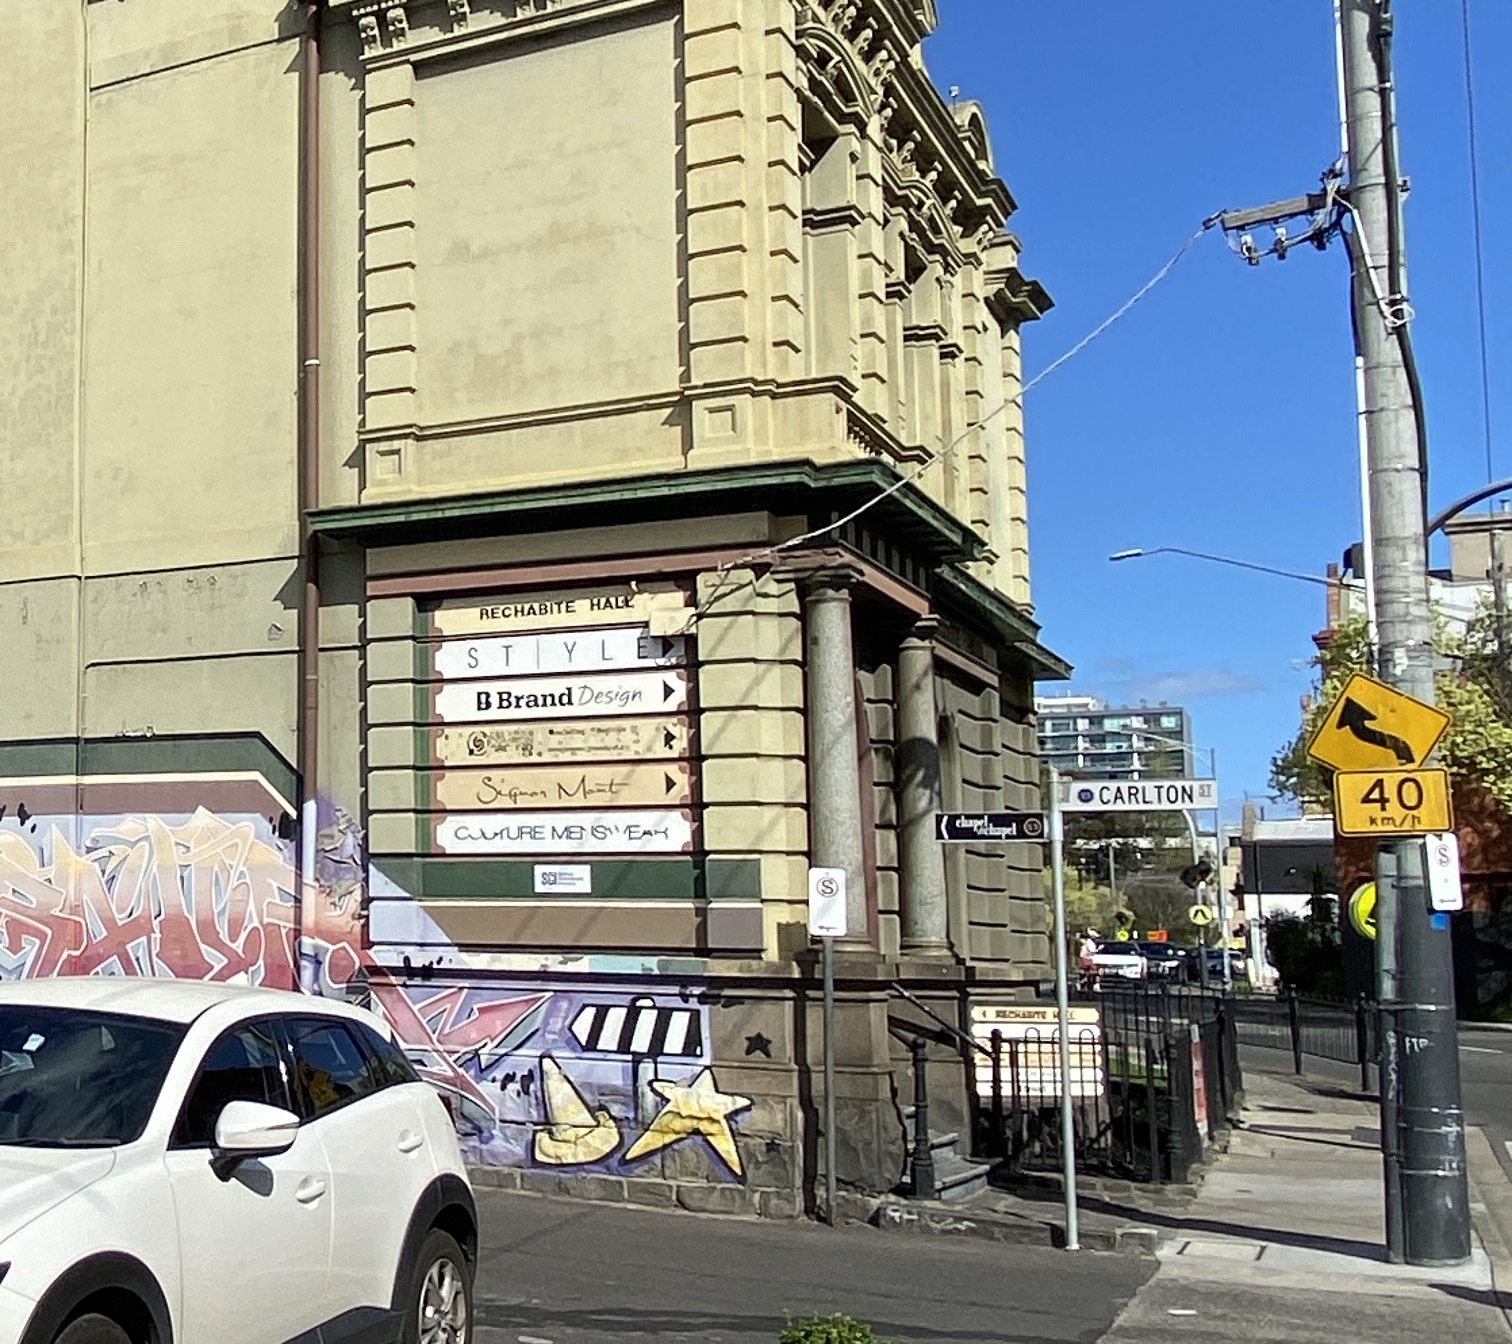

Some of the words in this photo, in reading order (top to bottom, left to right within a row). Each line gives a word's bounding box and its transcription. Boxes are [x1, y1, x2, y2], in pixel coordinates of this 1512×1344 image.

[479, 599, 576, 621] RECHABITE
[589, 595, 635, 612] HALL
[496, 686, 574, 710] Brand
[577, 683, 644, 707] Design
[1098, 784, 1194, 805] CARLTON
[1360, 777, 1424, 812] 40
[1369, 813, 1422, 829] km/h
